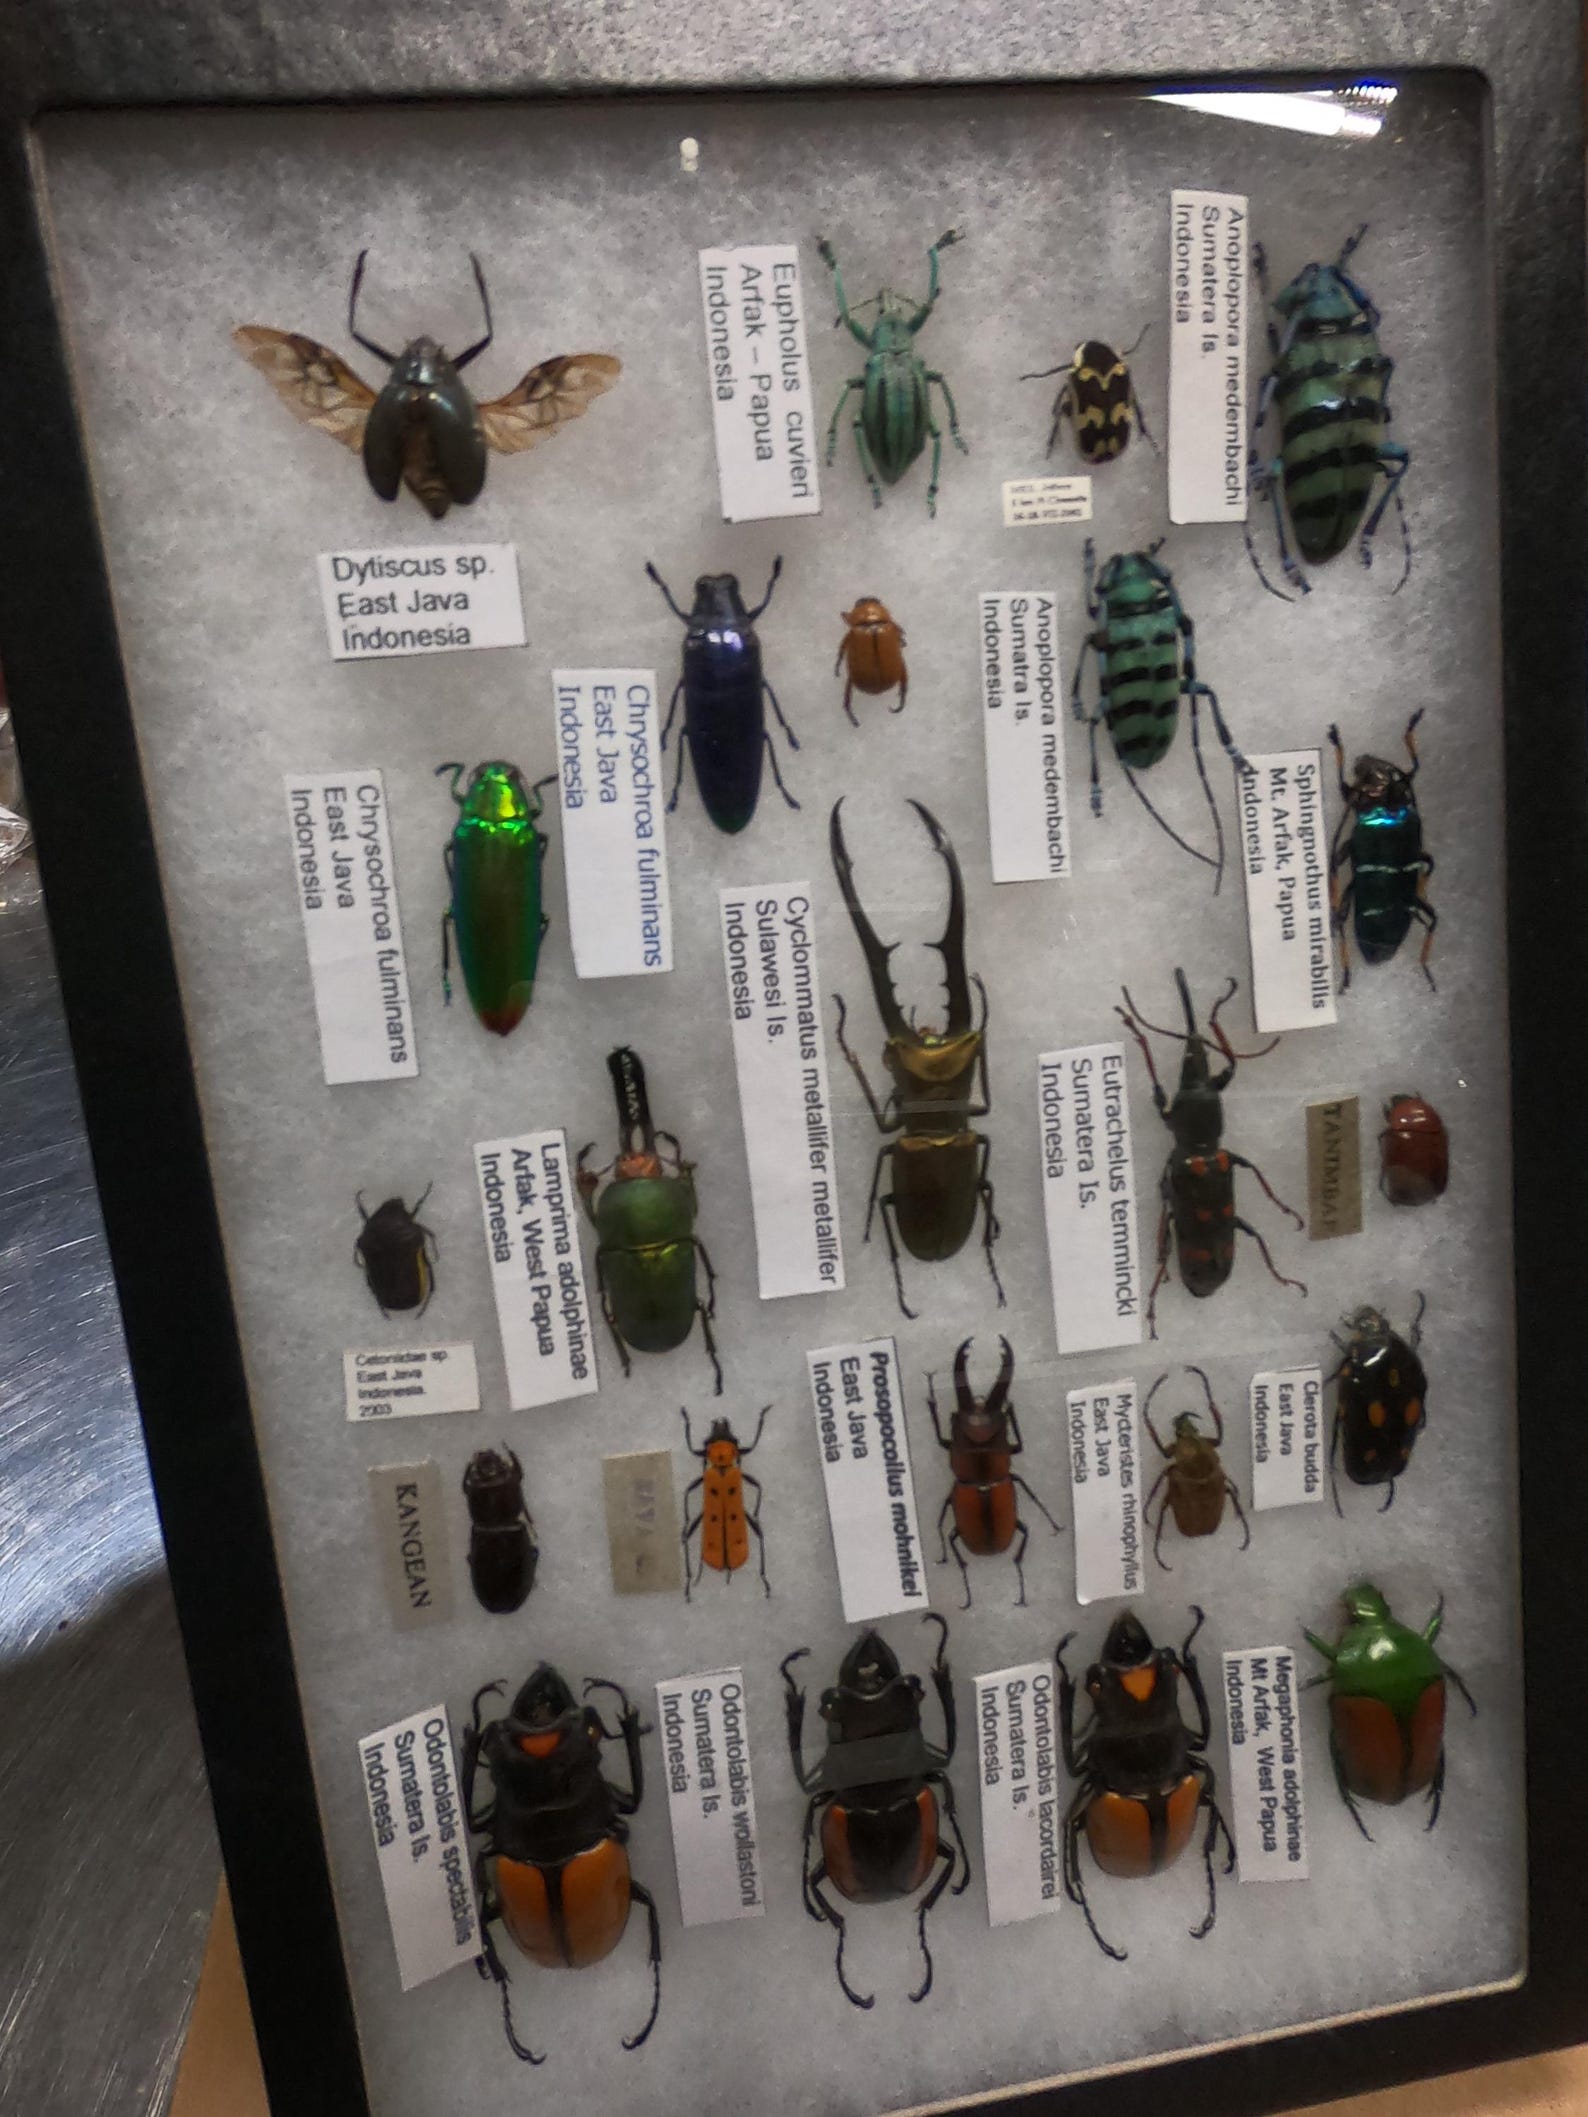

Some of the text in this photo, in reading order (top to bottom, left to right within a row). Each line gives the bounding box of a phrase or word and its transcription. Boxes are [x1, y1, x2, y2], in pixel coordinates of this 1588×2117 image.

[740, 263, 766, 338] Arfak
[1176, 204, 1194, 324] Indonesia
[1201, 206, 1220, 324] Sumatera
[1224, 207, 1244, 347] Anoplopora
[706, 266, 738, 401] Indonesia
[771, 263, 802, 392] Eupholus
[747, 374, 774, 462] Papua
[332, 555, 494, 586] Dytiscus sp.
[337, 590, 469, 618] East Java
[343, 624, 471, 650] Indonesia
[984, 599, 1005, 709] Indonesia
[1010, 599, 1029, 693] Sumatra
[1035, 598, 1056, 726] Anoplopora
[558, 686, 584, 810] Indonesia
[593, 685, 619, 803] East Java
[291, 789, 323, 910] Indonesia
[323, 786, 355, 909] East Java
[625, 684, 662, 967] Chrysochroa fulminans
[356, 784, 408, 1064] Chrysochroa fulminans
[1275, 877, 1296, 942] Papua
[1294, 763, 1330, 1009] Sphingnothus mirabilis
[725, 902, 755, 1021] Indonesia
[755, 899, 784, 1008] Sulawesi
[784, 896, 839, 1284] Cyclommatus metallifer metallifer
[1041, 1063, 1068, 1179] Indonesia
[1071, 1058, 1096, 1173] Sumatera
[481, 1152, 514, 1264] Indonesia
[1102, 1055, 1138, 1317] Eutrachelus temmincki
[511, 1148, 556, 1356] Arfak, West Papua
[541, 1142, 589, 1380] Lamprima adolphinae
[813, 1361, 844, 1463] Indonesia
[839, 1356, 868, 1459] East Java
[1071, 1401, 1089, 1484] Indonesia
[1093, 1397, 1112, 1478] East Java
[1255, 1385, 1271, 1464] Indonesia
[1279, 1383, 1295, 1456] East Java
[396, 1482, 432, 1608] KANGEAN
[663, 1692, 691, 1794] Indonesia
[691, 1689, 717, 1791] Sumatera
[720, 1683, 748, 1808] Odontolabis
[981, 1686, 1004, 1786] Indonesia
[1005, 1679, 1029, 1782] Sumatera
[1032, 1674, 1056, 1797] Odontolabis
[1226, 1659, 1246, 1746] Indonesia
[364, 1742, 398, 1847] Indonesia
[394, 1730, 425, 1835] Sumatera
[423, 1718, 459, 1843] Odontolabis
[1257, 1746, 1275, 1792] West
[1273, 1656, 1301, 1863] Megaphonia adolphinae
[1257, 1797, 1278, 1853] Papua
